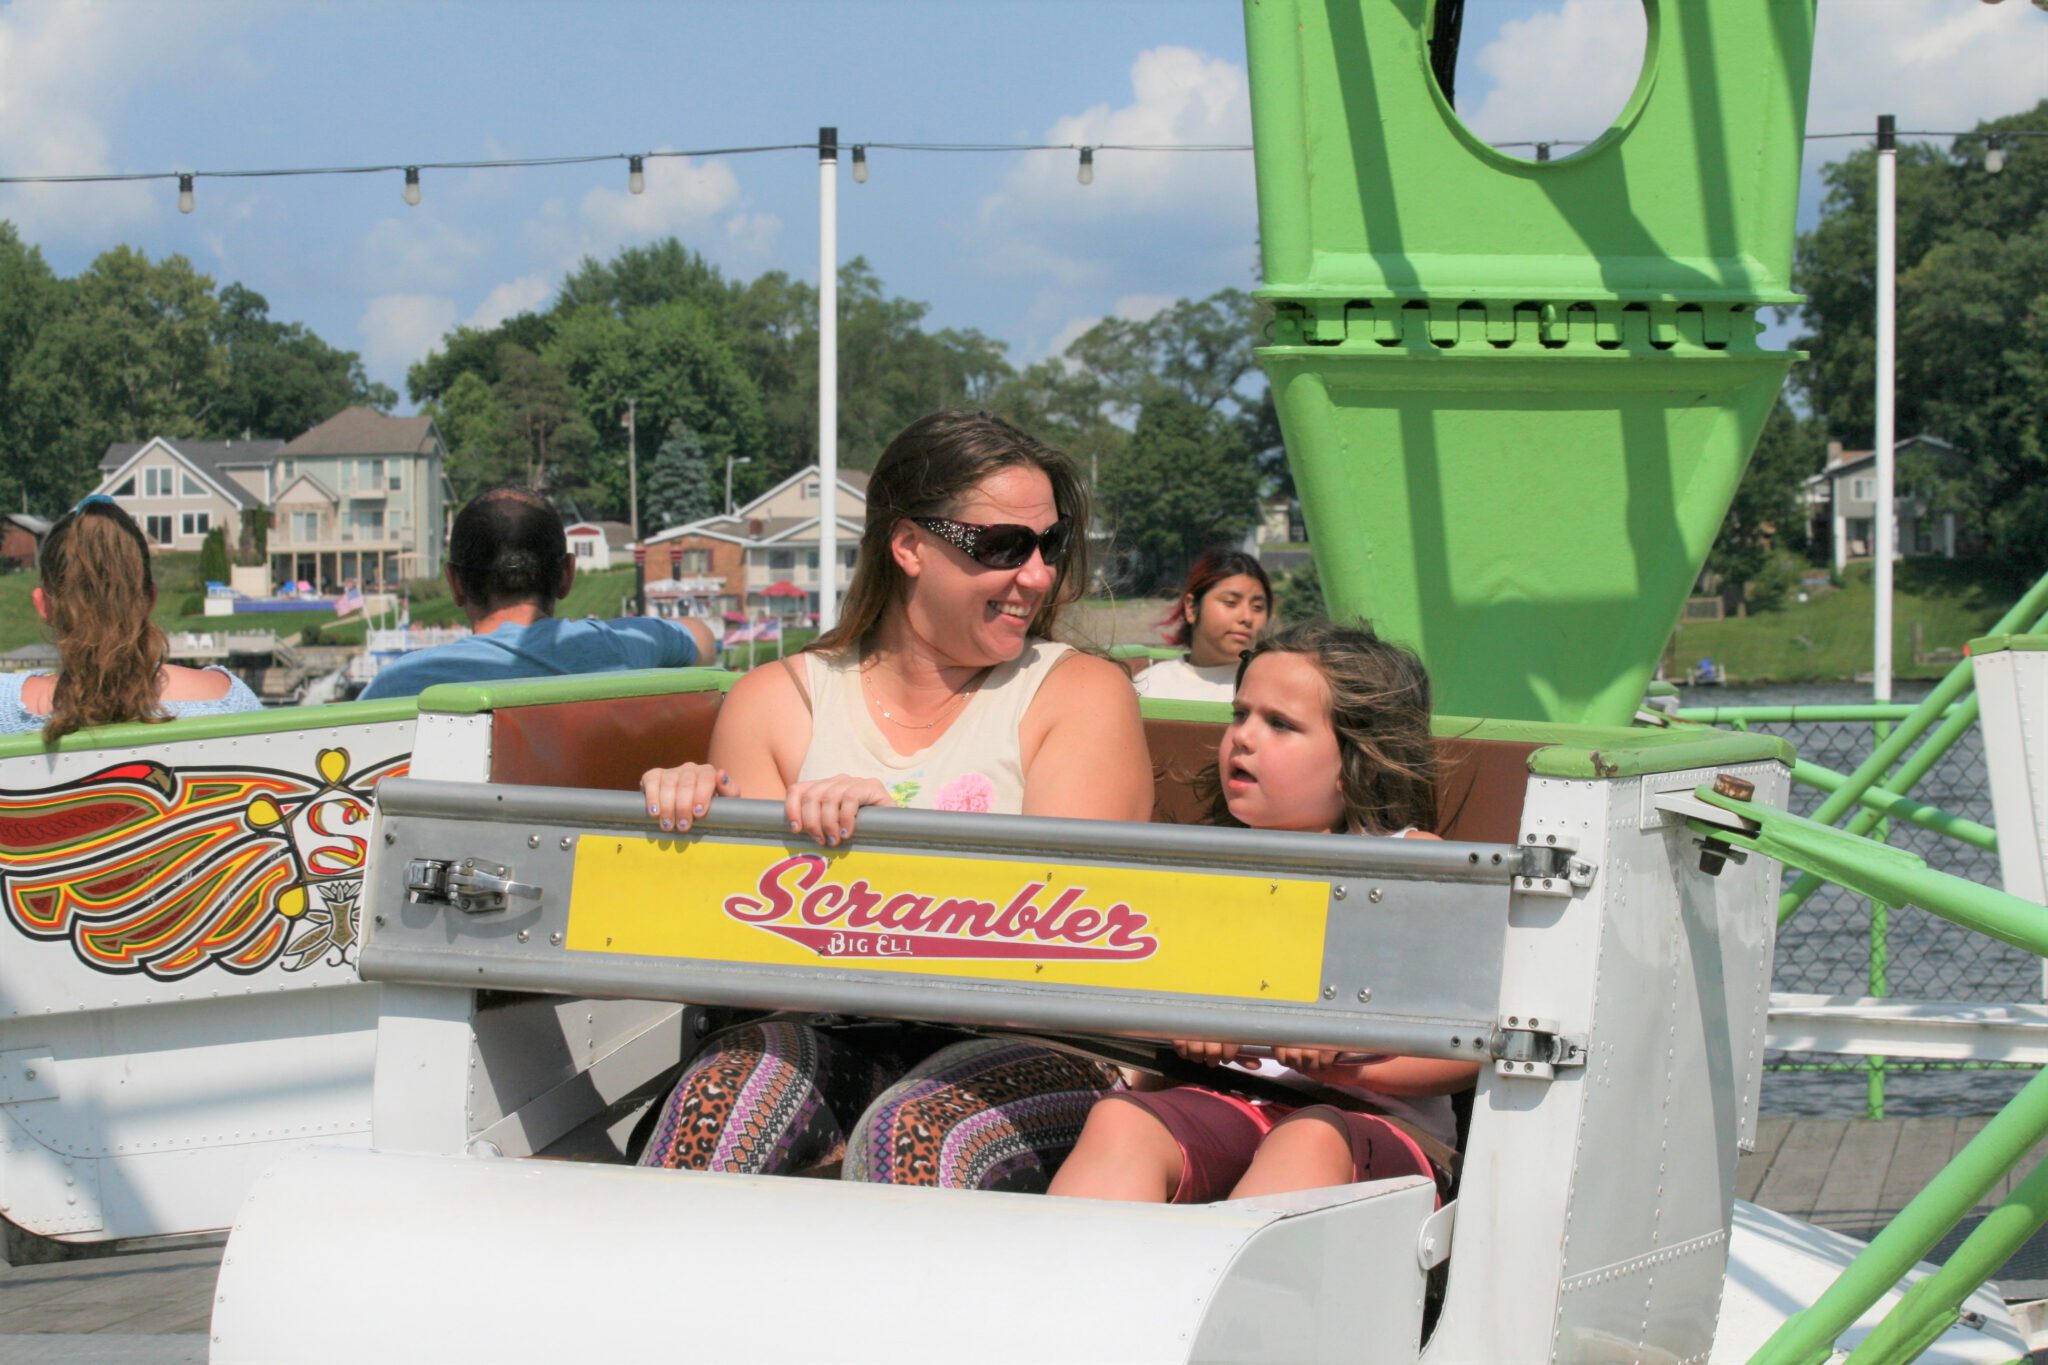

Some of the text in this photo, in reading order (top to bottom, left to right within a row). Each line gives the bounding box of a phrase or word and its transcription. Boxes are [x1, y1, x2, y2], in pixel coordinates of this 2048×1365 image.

[723, 853, 1158, 952] Scrambler
[827, 932, 913, 955] BIG ELI
